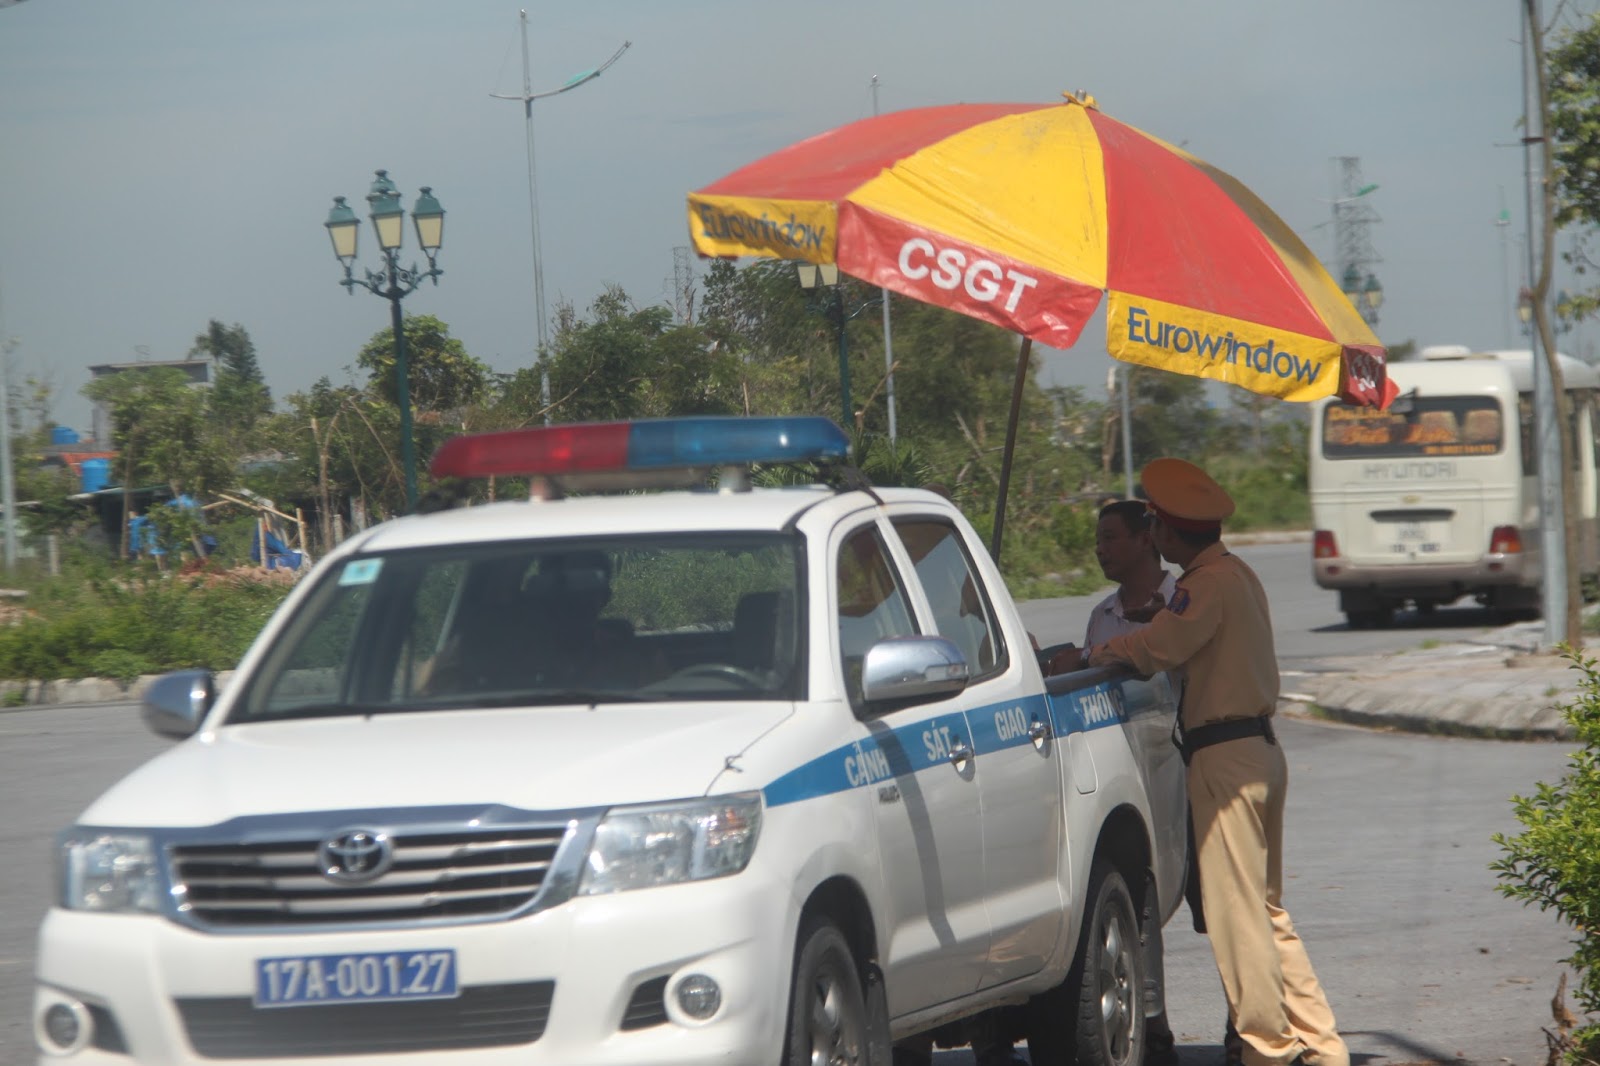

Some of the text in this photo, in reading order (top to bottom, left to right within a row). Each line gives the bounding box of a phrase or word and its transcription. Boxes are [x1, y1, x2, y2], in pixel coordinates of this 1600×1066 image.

[700, 203, 826, 249] Eurowindow
[899, 237, 1038, 314] CSGT
[1127, 306, 1322, 385] Eurowindow
[844, 685, 1125, 787] CẢNH SÁT GIAO THÔNG
[262, 952, 452, 1001] 17A-001.27
